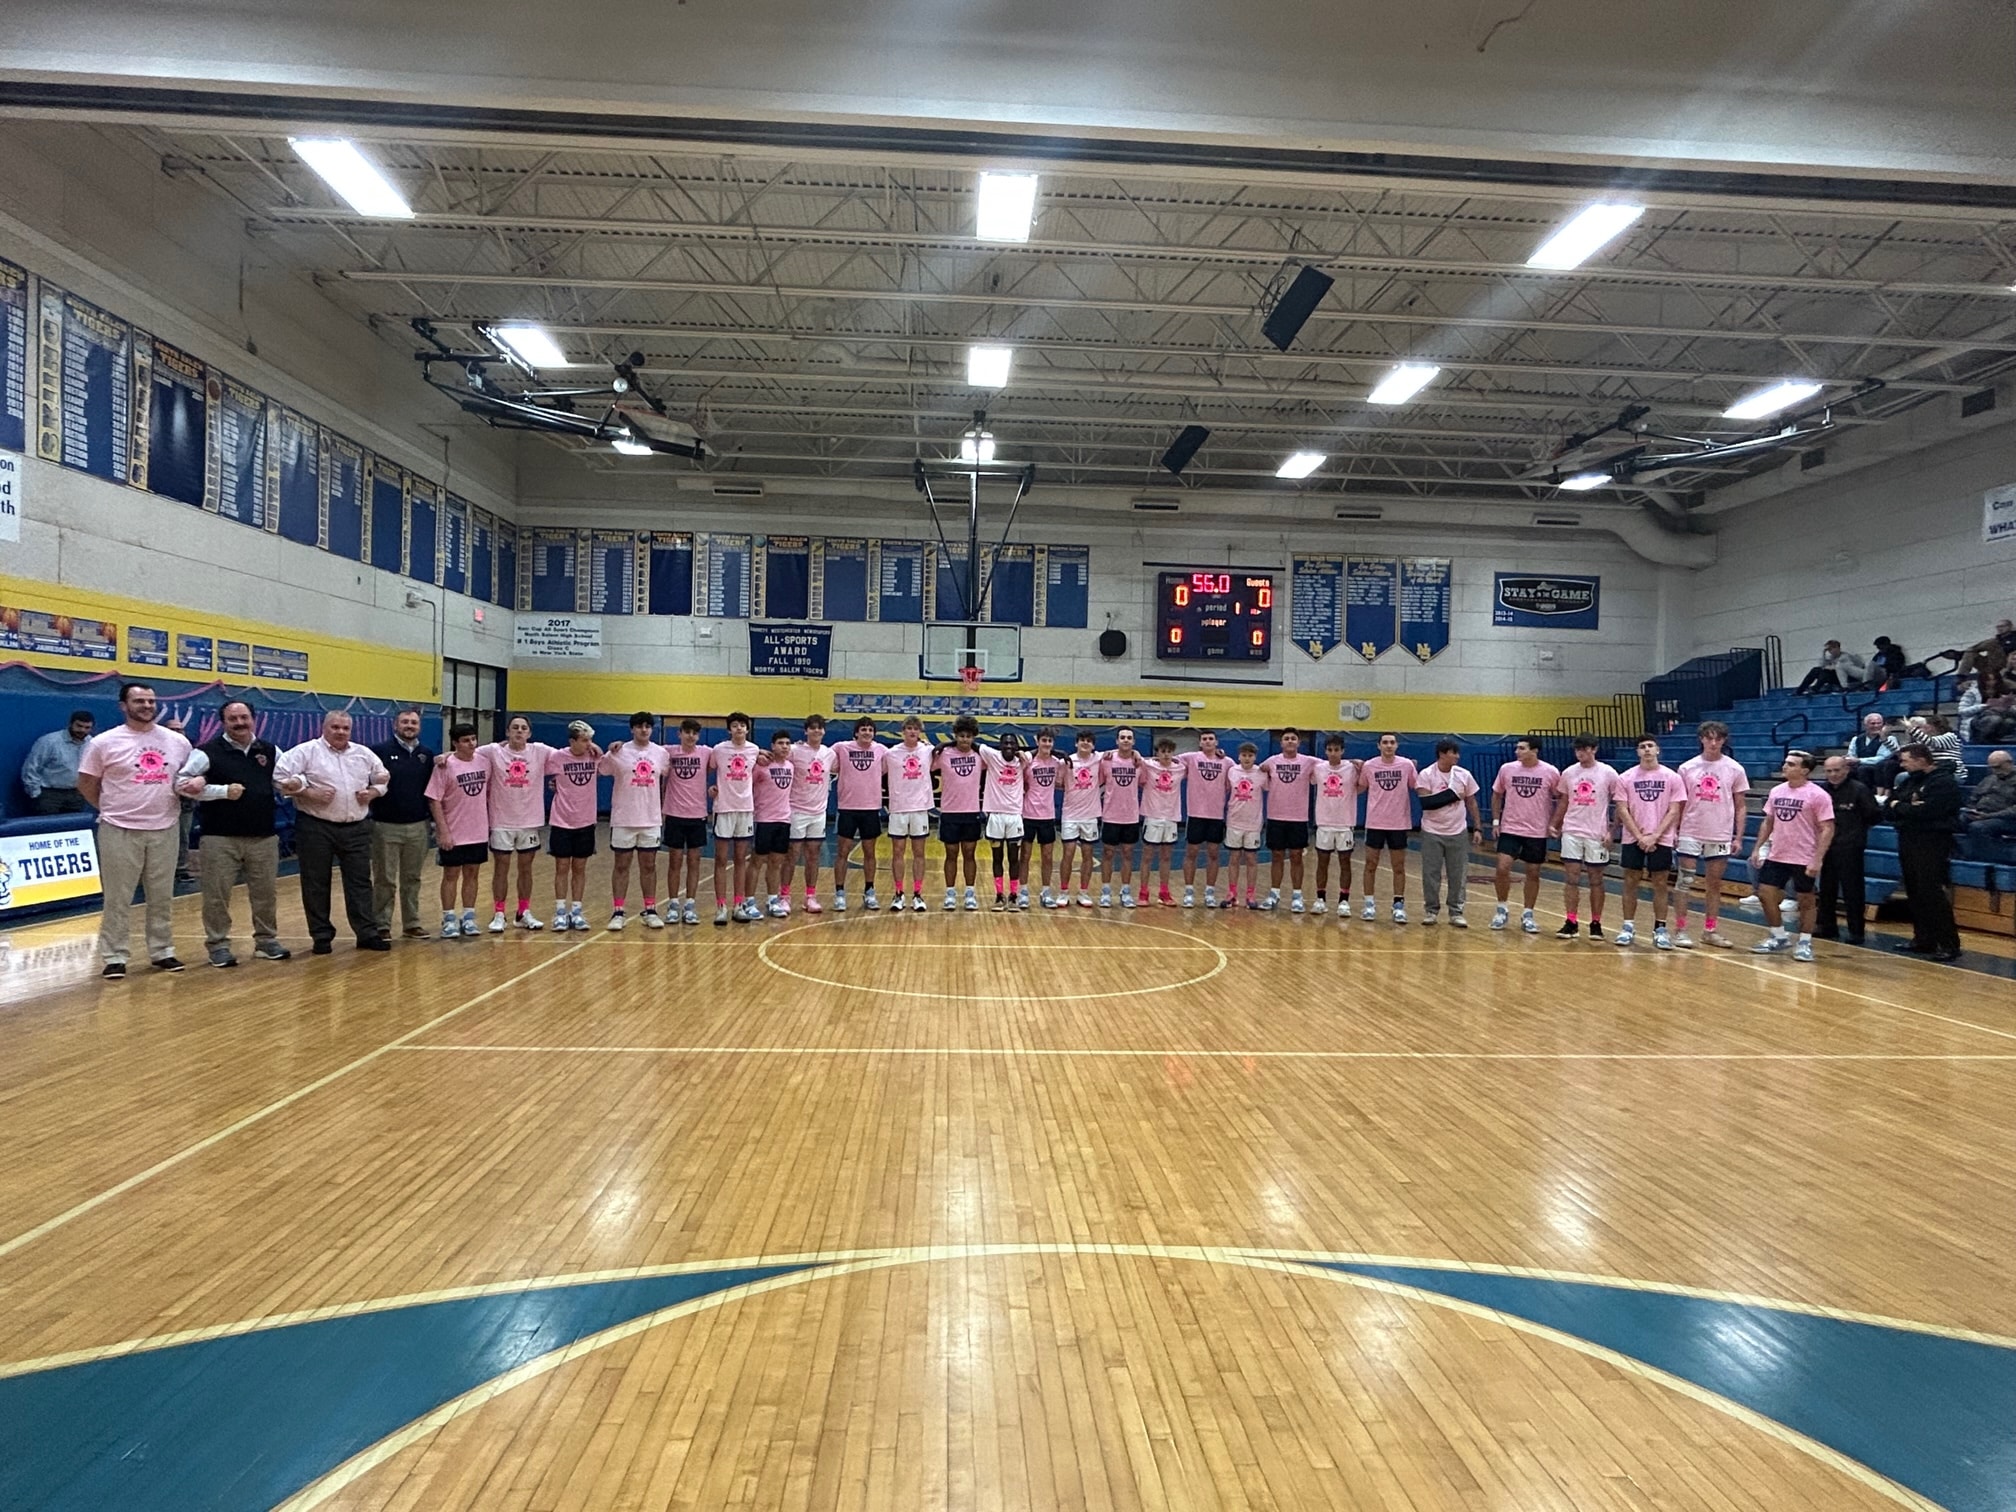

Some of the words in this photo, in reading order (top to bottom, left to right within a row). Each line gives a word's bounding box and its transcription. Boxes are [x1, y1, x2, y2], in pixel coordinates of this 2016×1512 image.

[74, 308, 120, 341] TIGERS
[159, 350, 198, 378] TIGERS
[1175, 585, 1188, 606] 0
[1258, 588, 1271, 607] 0
[1504, 587, 1536, 598] STAY
[1552, 589, 1590, 600] GAME
[1205, 604, 1227, 612] period
[1171, 628, 1182, 643] 0
[1253, 630, 1263, 645] 0
[774, 646, 807, 655] AWARD
[769, 657, 788, 665] FALL
[849, 750, 874, 758] WESTLAKE
[672, 757, 701, 766] WESTLAKE
[950, 756, 976, 765] WESTLAKE
[563, 762, 595, 772] WESTLAKE
[1198, 761, 1222, 770] WESTLAKE
[1033, 767, 1056, 776] WESTLAKE
[1112, 767, 1136, 775] WESTLAKE
[1375, 770, 1402, 779] WESTLAKE
[456, 771, 486, 784] WESTLAKE
[1512, 776, 1543, 785] WESTLAKE
[1633, 781, 1665, 789] WESTLAKE
[1773, 797, 1804, 807] WESTLAKE
[28, 840, 52, 851] HOME
[53, 839, 64, 848] OF
[64, 837, 80, 847] THE
[18, 852, 92, 880] TIGERS
